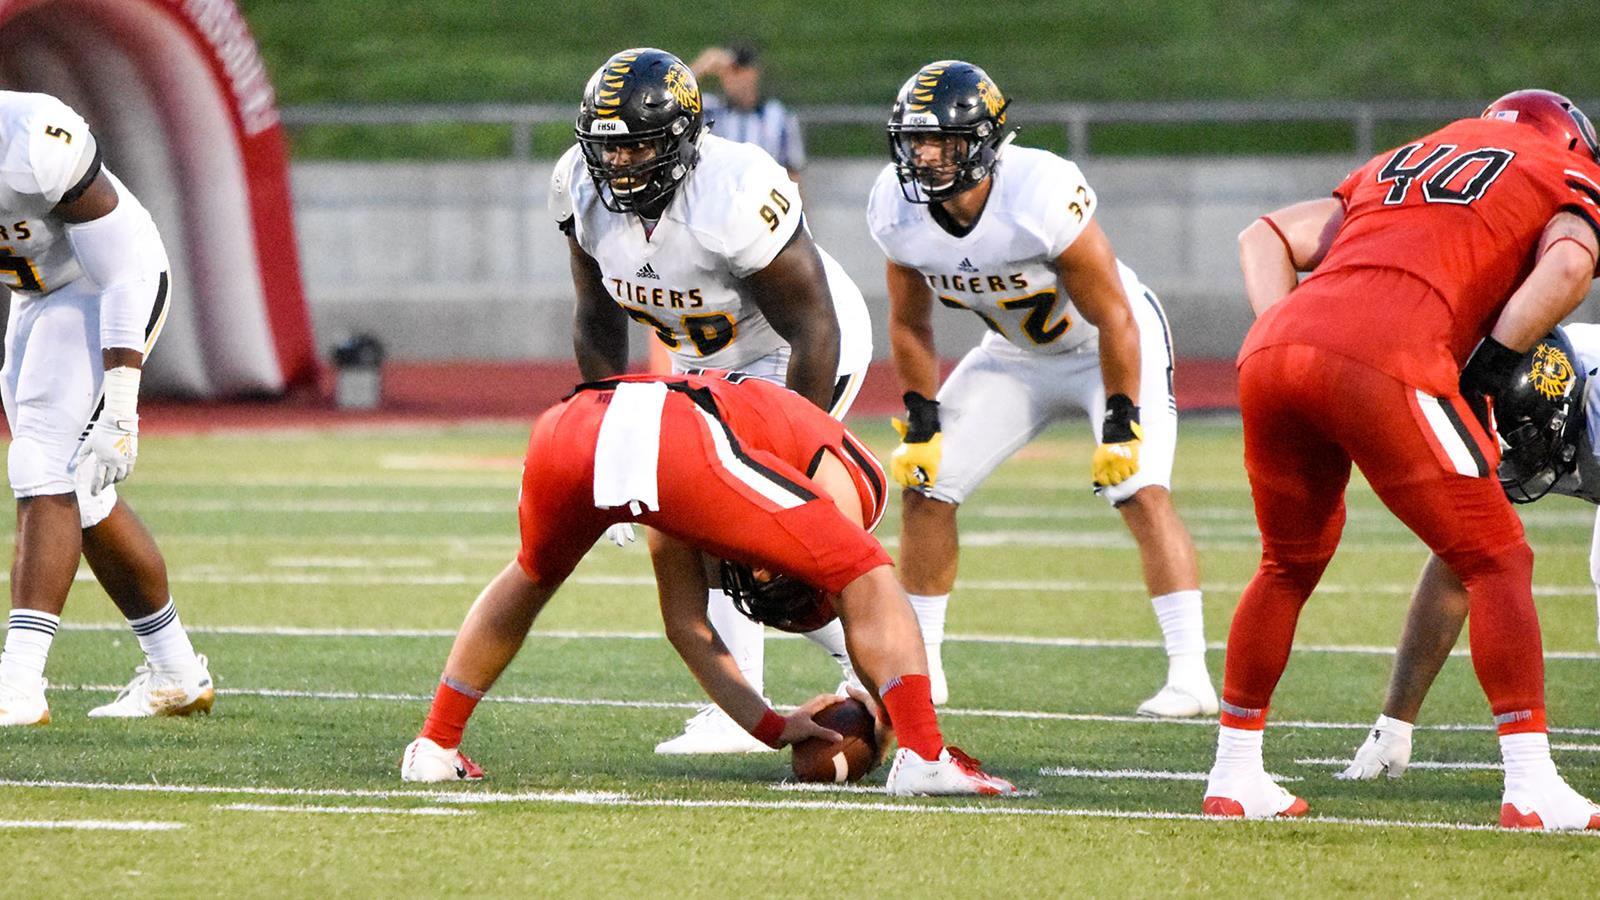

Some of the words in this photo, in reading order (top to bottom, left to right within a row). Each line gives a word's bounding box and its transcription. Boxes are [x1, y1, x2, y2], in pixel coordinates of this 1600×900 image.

[45, 124, 72, 144] 5
[597, 122, 616, 131] FHSU
[1376, 142, 1517, 206] 40
[759, 187, 791, 232] 90
[1068, 184, 1091, 223] 32
[635, 271, 660, 280] adidas
[927, 272, 1028, 294] TIGERS
[611, 278, 703, 309] TIGERS
